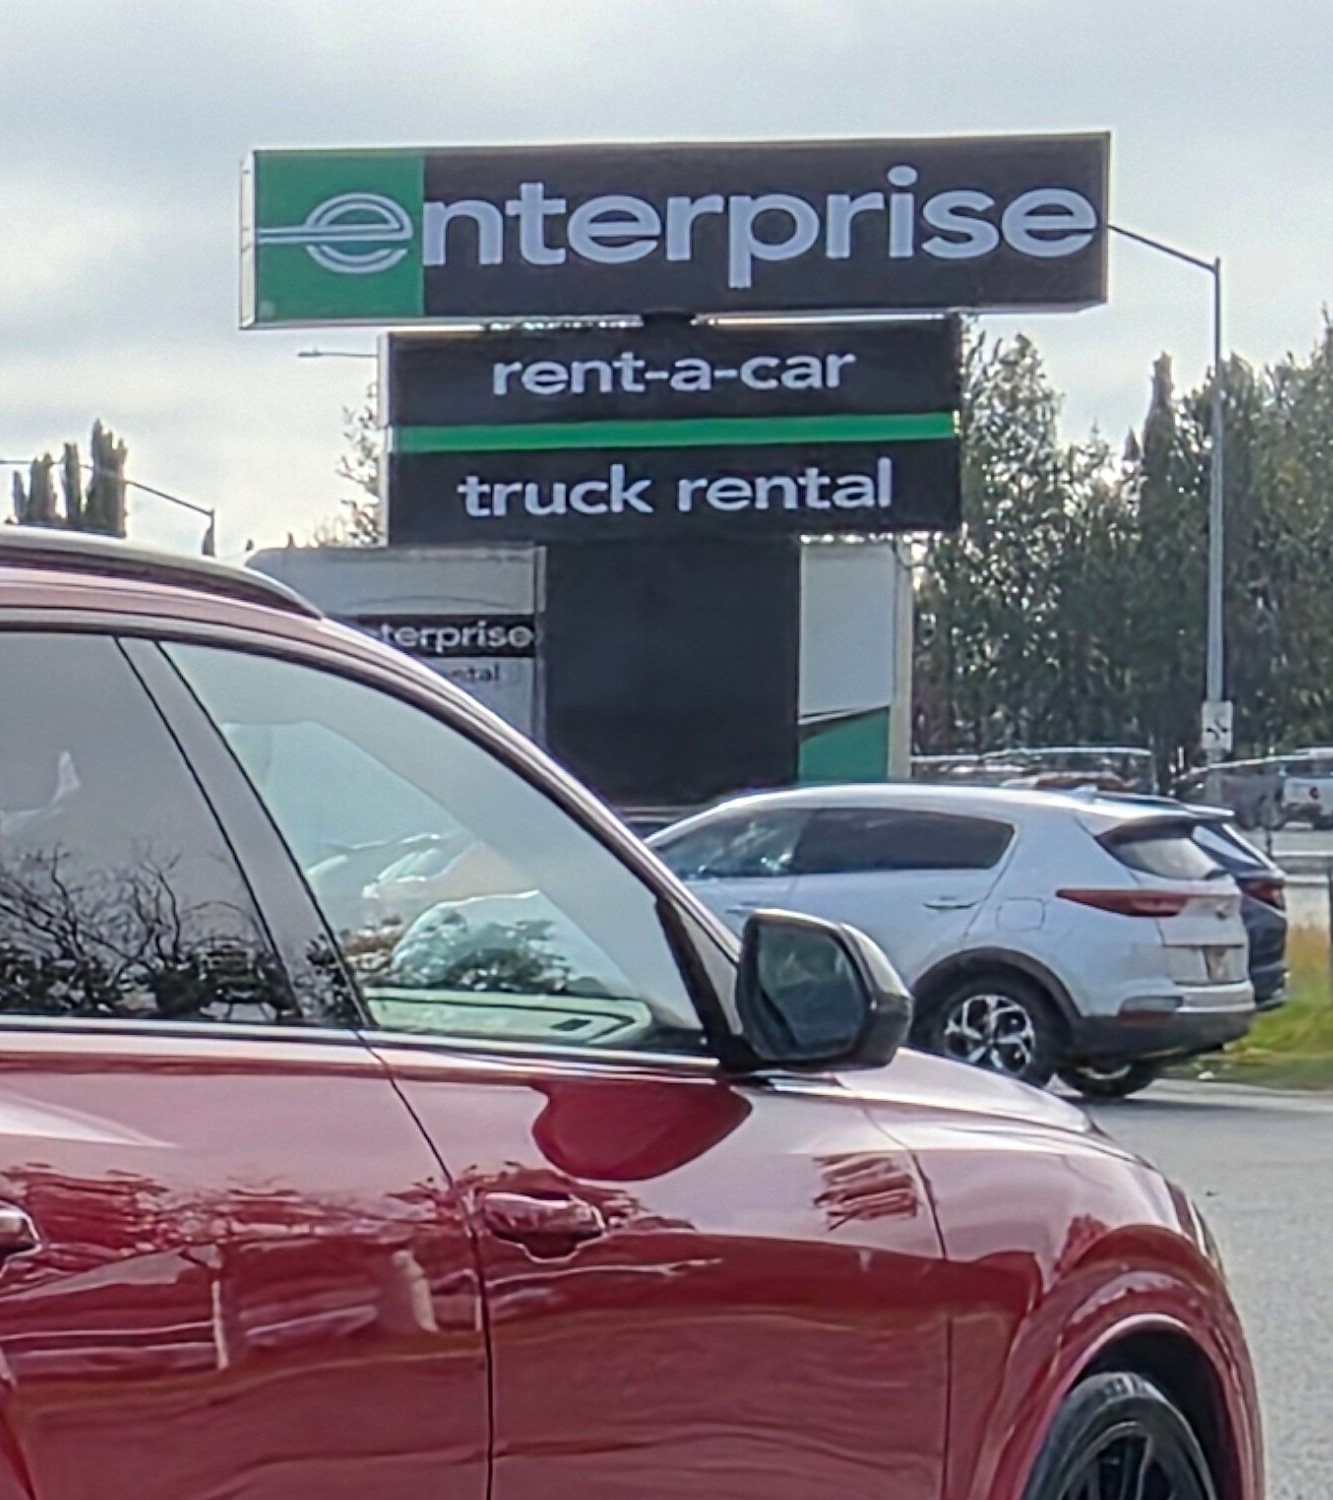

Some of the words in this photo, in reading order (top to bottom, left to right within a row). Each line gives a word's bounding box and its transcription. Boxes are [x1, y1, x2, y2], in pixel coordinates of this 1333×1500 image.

[301, 165, 1099, 290] enterprise
[491, 347, 857, 397] rent-a-car
[458, 464, 654, 518] truck
[676, 457, 894, 513] rental
